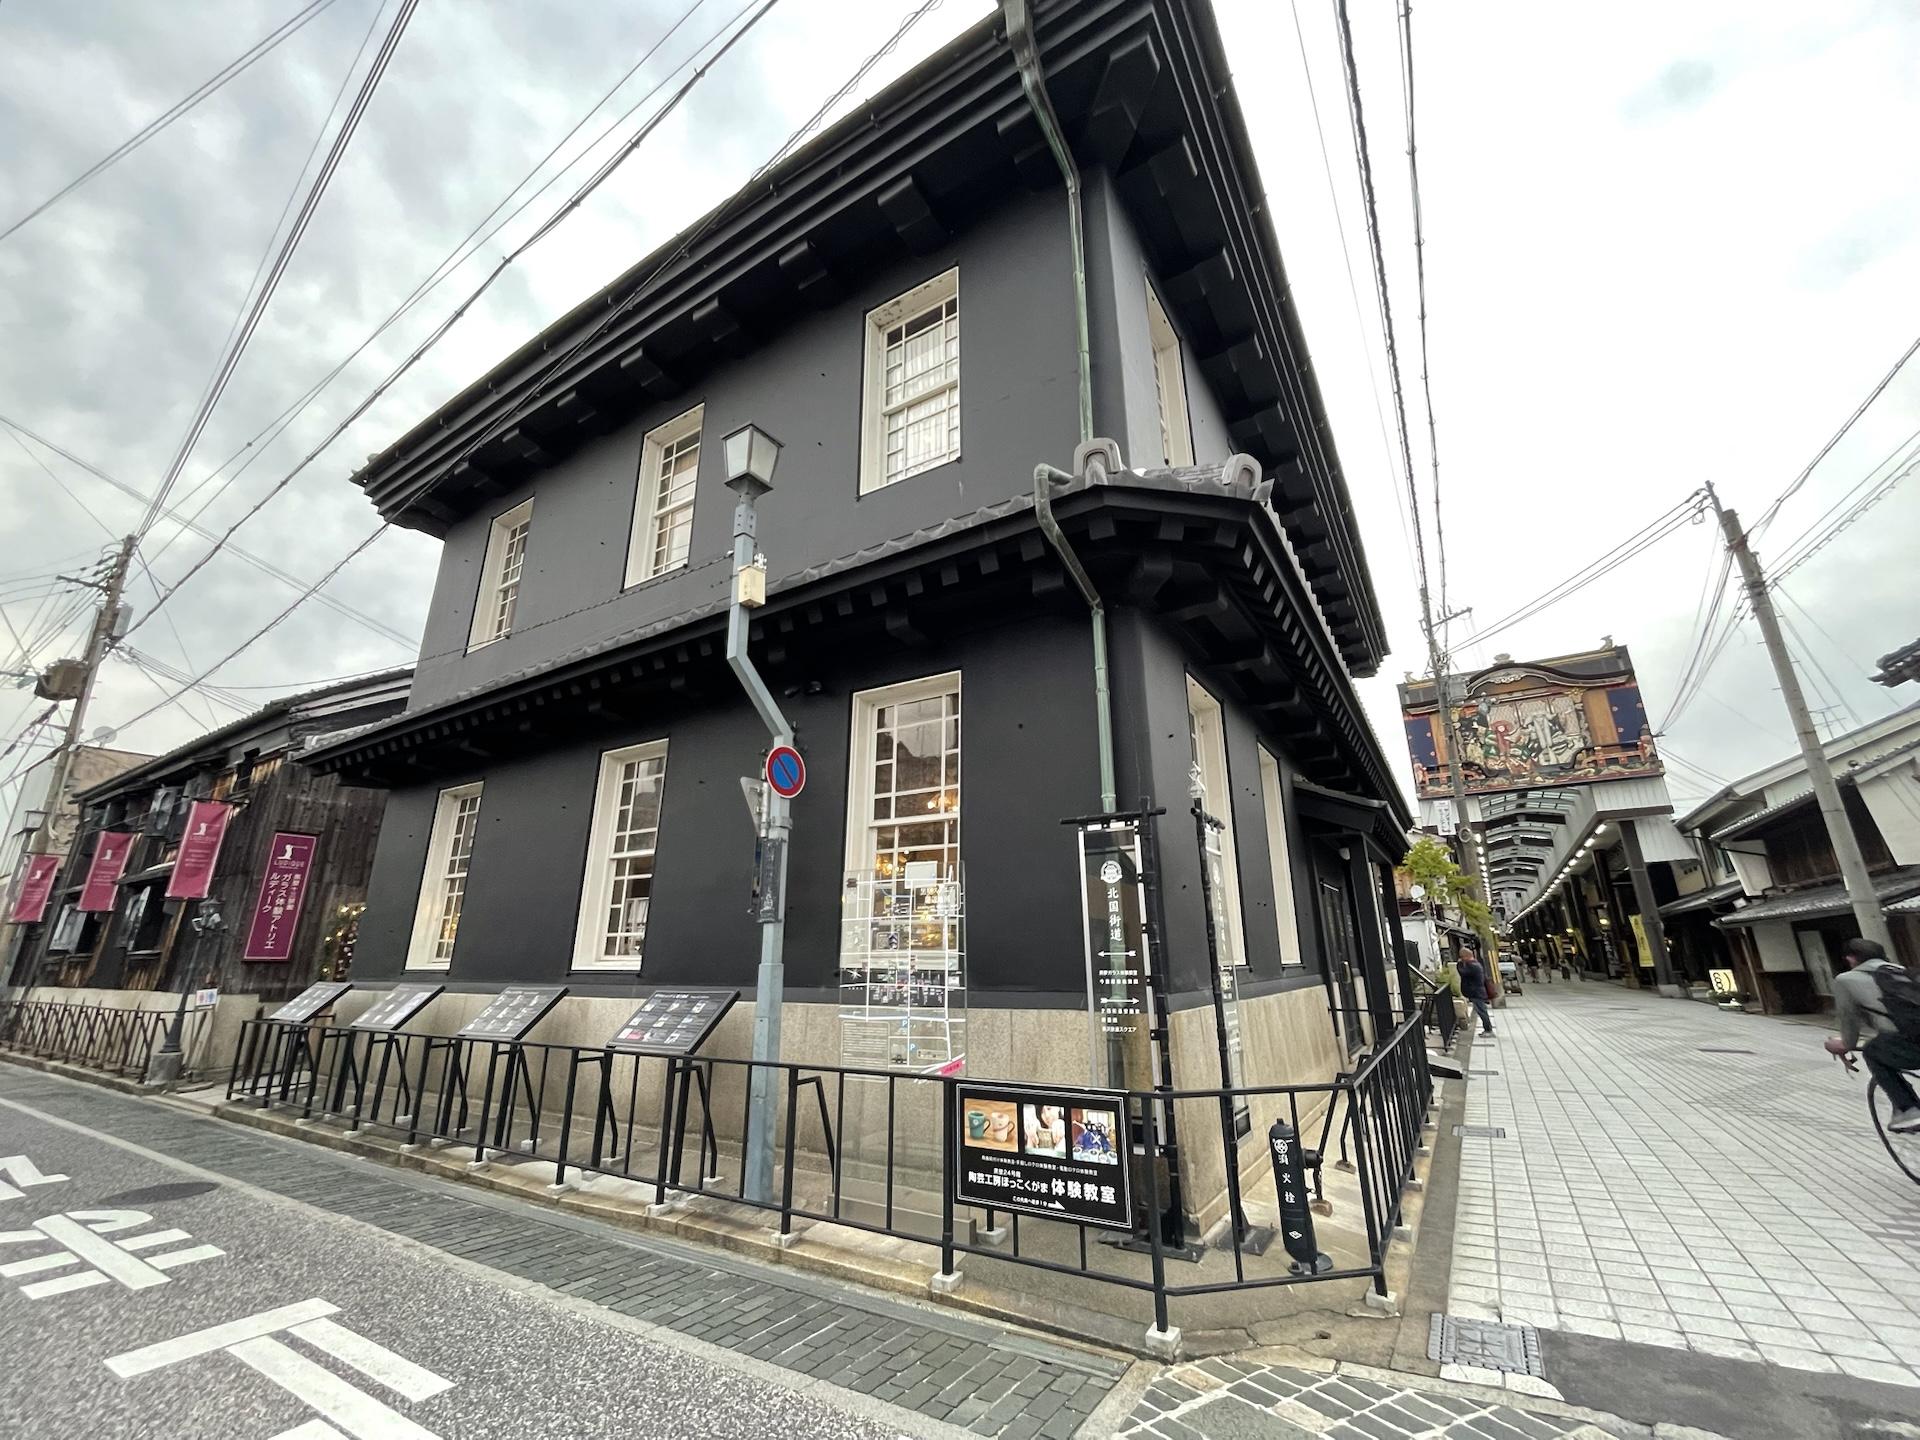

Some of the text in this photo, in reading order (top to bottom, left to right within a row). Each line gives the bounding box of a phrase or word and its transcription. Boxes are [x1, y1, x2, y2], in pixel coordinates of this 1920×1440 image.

[262, 872, 281, 913] ルディーク
[1106, 887, 1123, 942] 北国街道
[968, 1170, 1116, 1205] 陶芸工房ほっこくがま 体験教室
[1278, 1154, 1296, 1204] 消火栓
